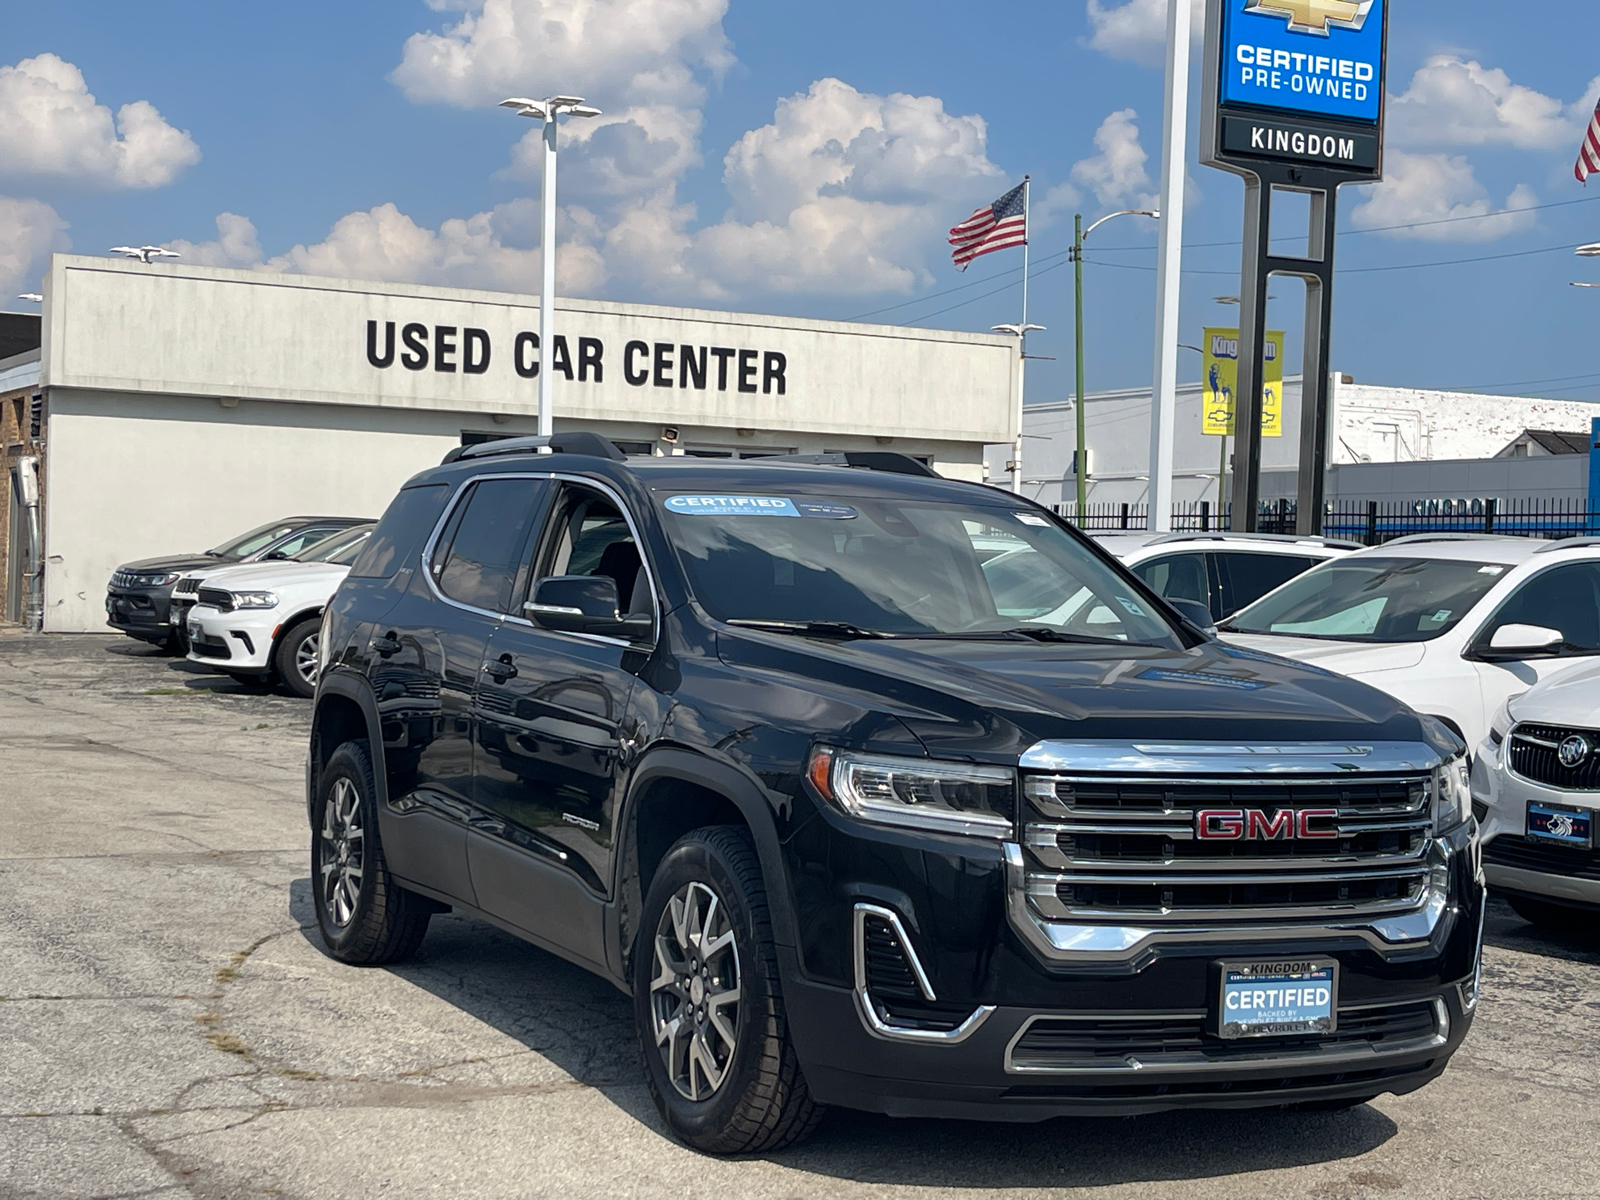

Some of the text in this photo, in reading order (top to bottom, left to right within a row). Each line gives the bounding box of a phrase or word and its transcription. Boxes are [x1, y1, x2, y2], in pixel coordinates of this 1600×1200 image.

[1237, 44, 1373, 81] CERTIFIED
[1242, 67, 1367, 101] PRE-OWNED
[1252, 127, 1353, 159] KINGDOM
[366, 320, 788, 395] USED CAR CENTER
[670, 497, 786, 509] CERTIFIED
[1196, 808, 1338, 841] GMC
[1250, 962, 1311, 974] KINGDOM
[1225, 988, 1330, 1010] CERTIFIED
[1257, 1010, 1285, 1018] BACKED
